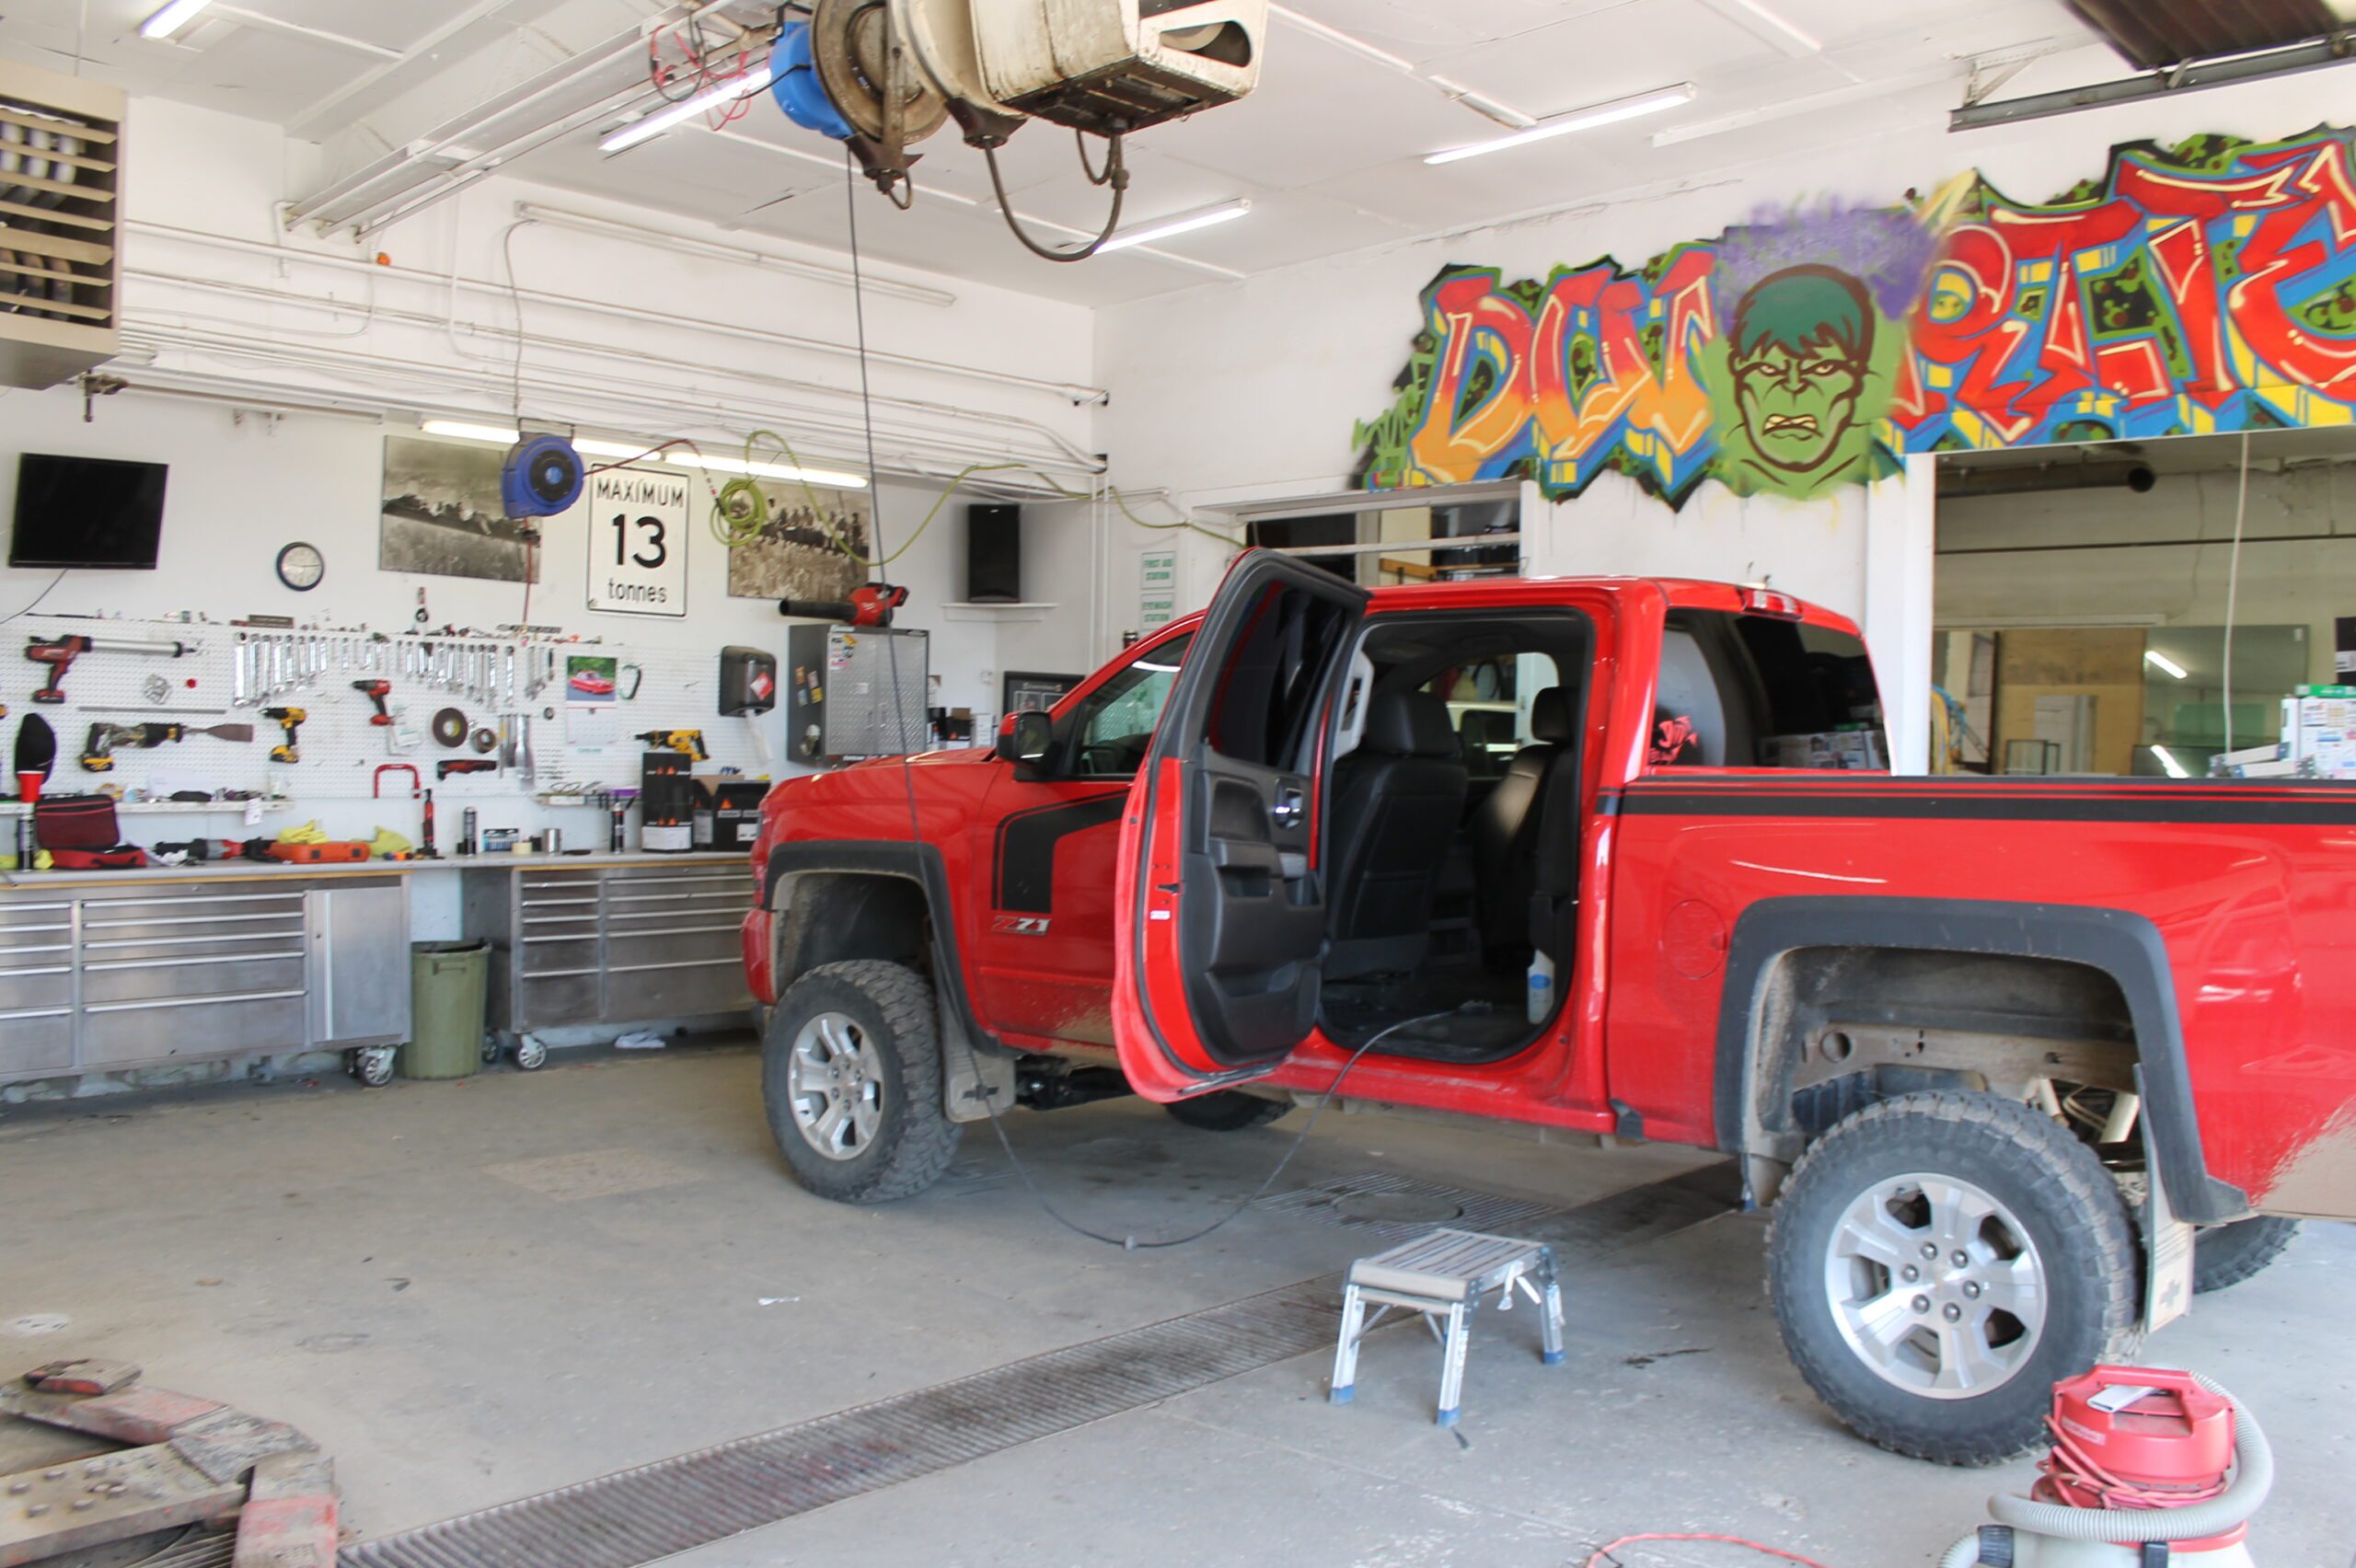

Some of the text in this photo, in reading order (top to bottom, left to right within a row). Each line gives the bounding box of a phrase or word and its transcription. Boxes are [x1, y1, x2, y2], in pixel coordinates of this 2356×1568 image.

[596, 477, 685, 508] MAXIMUM
[611, 513, 666, 569] 13
[607, 577, 668, 604] tonnes
